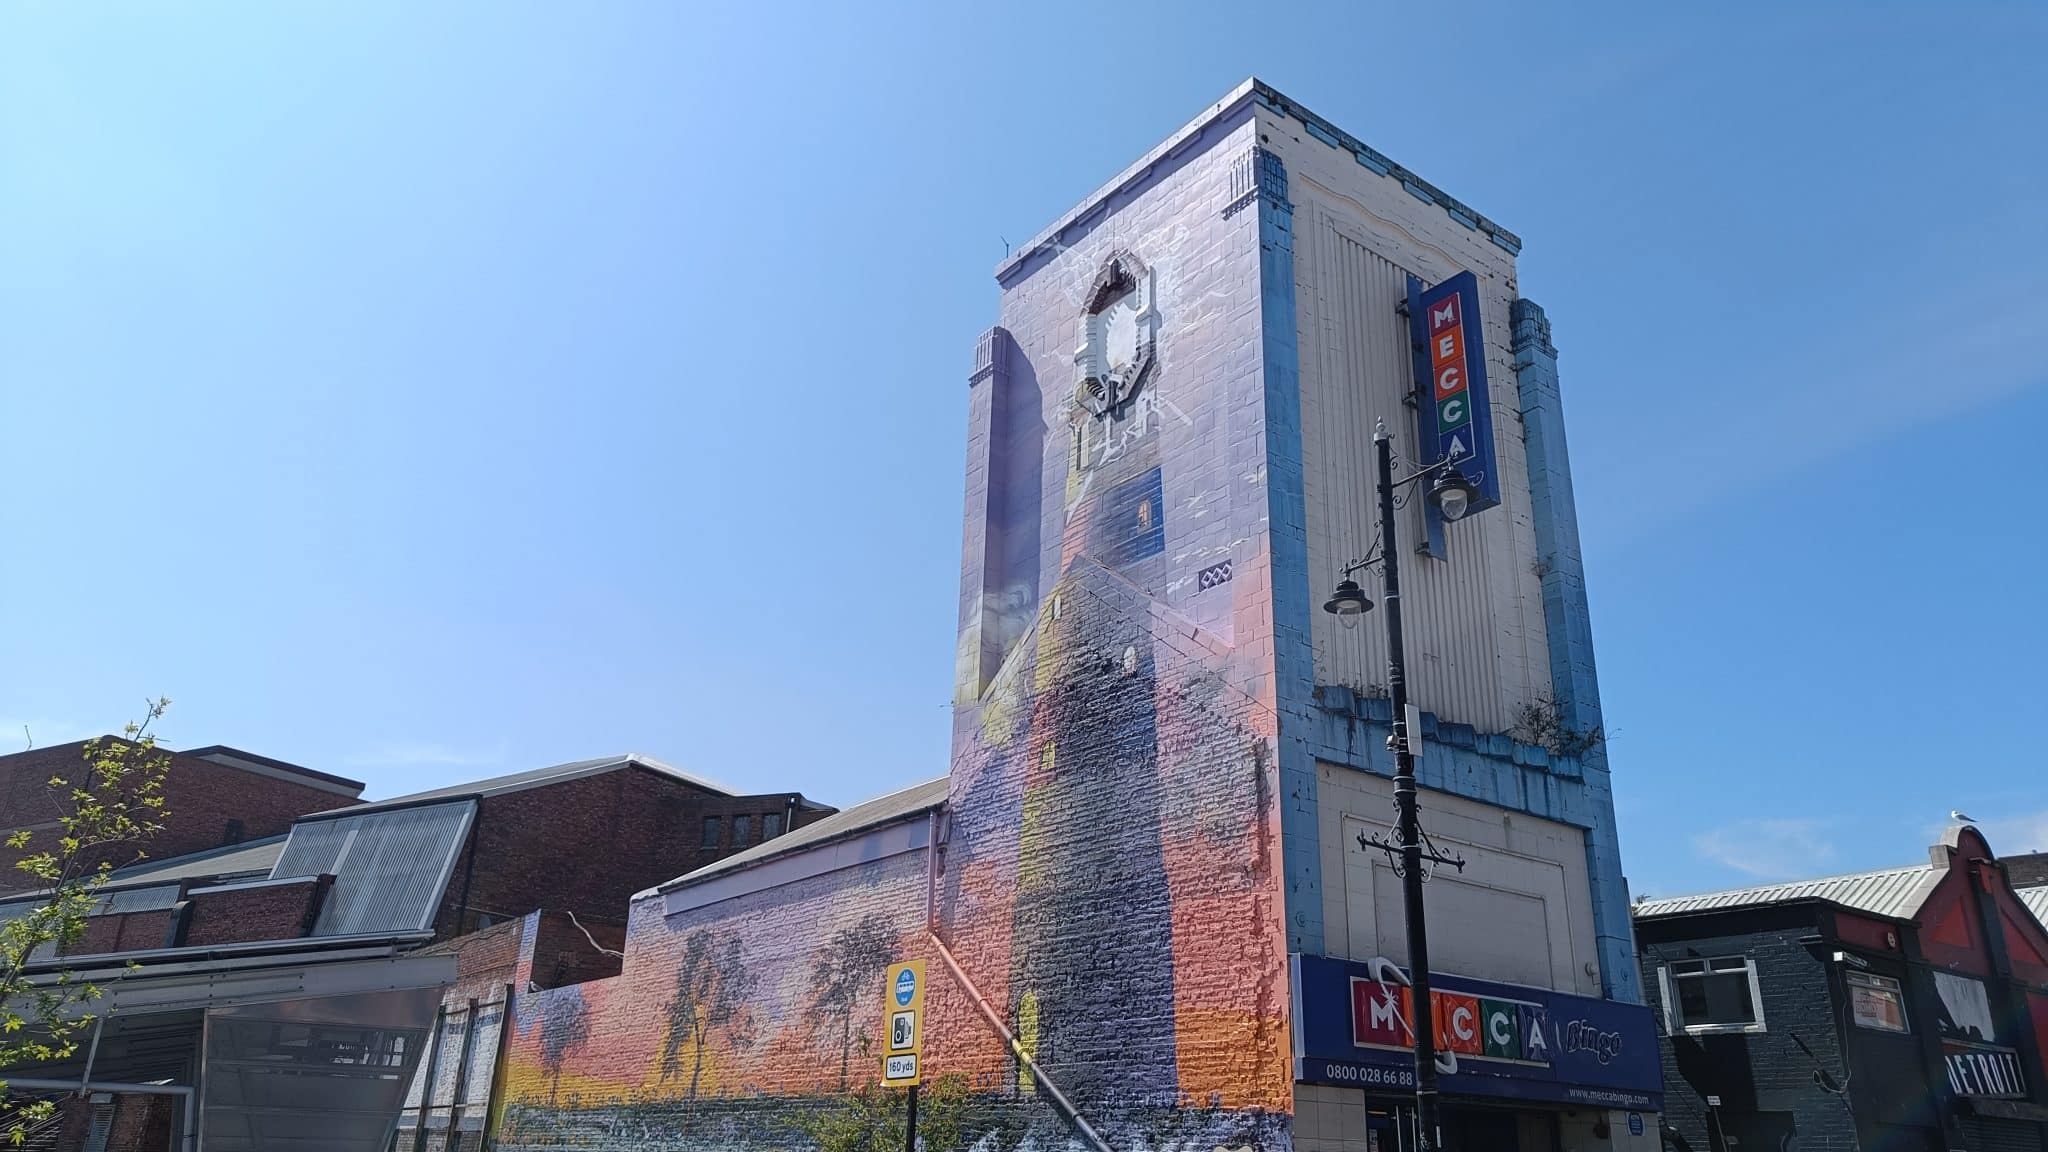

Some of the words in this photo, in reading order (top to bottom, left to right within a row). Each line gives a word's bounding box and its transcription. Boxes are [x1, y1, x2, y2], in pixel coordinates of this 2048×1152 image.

[1433, 301, 1467, 457] MECCA
[1370, 996, 1547, 1051] MCCA
[1566, 1019, 1623, 1065] Bingo
[902, 1060, 914, 1073] yds
[1326, 1064, 1357, 1080] 0800
[1360, 1067, 1382, 1083] 028
[1383, 1070, 1398, 1084] 66
[1399, 1071, 1413, 1086] 88
[1945, 1054, 2020, 1095] DETROIT
[1568, 1087, 1650, 1105] www.meccabingo.com
